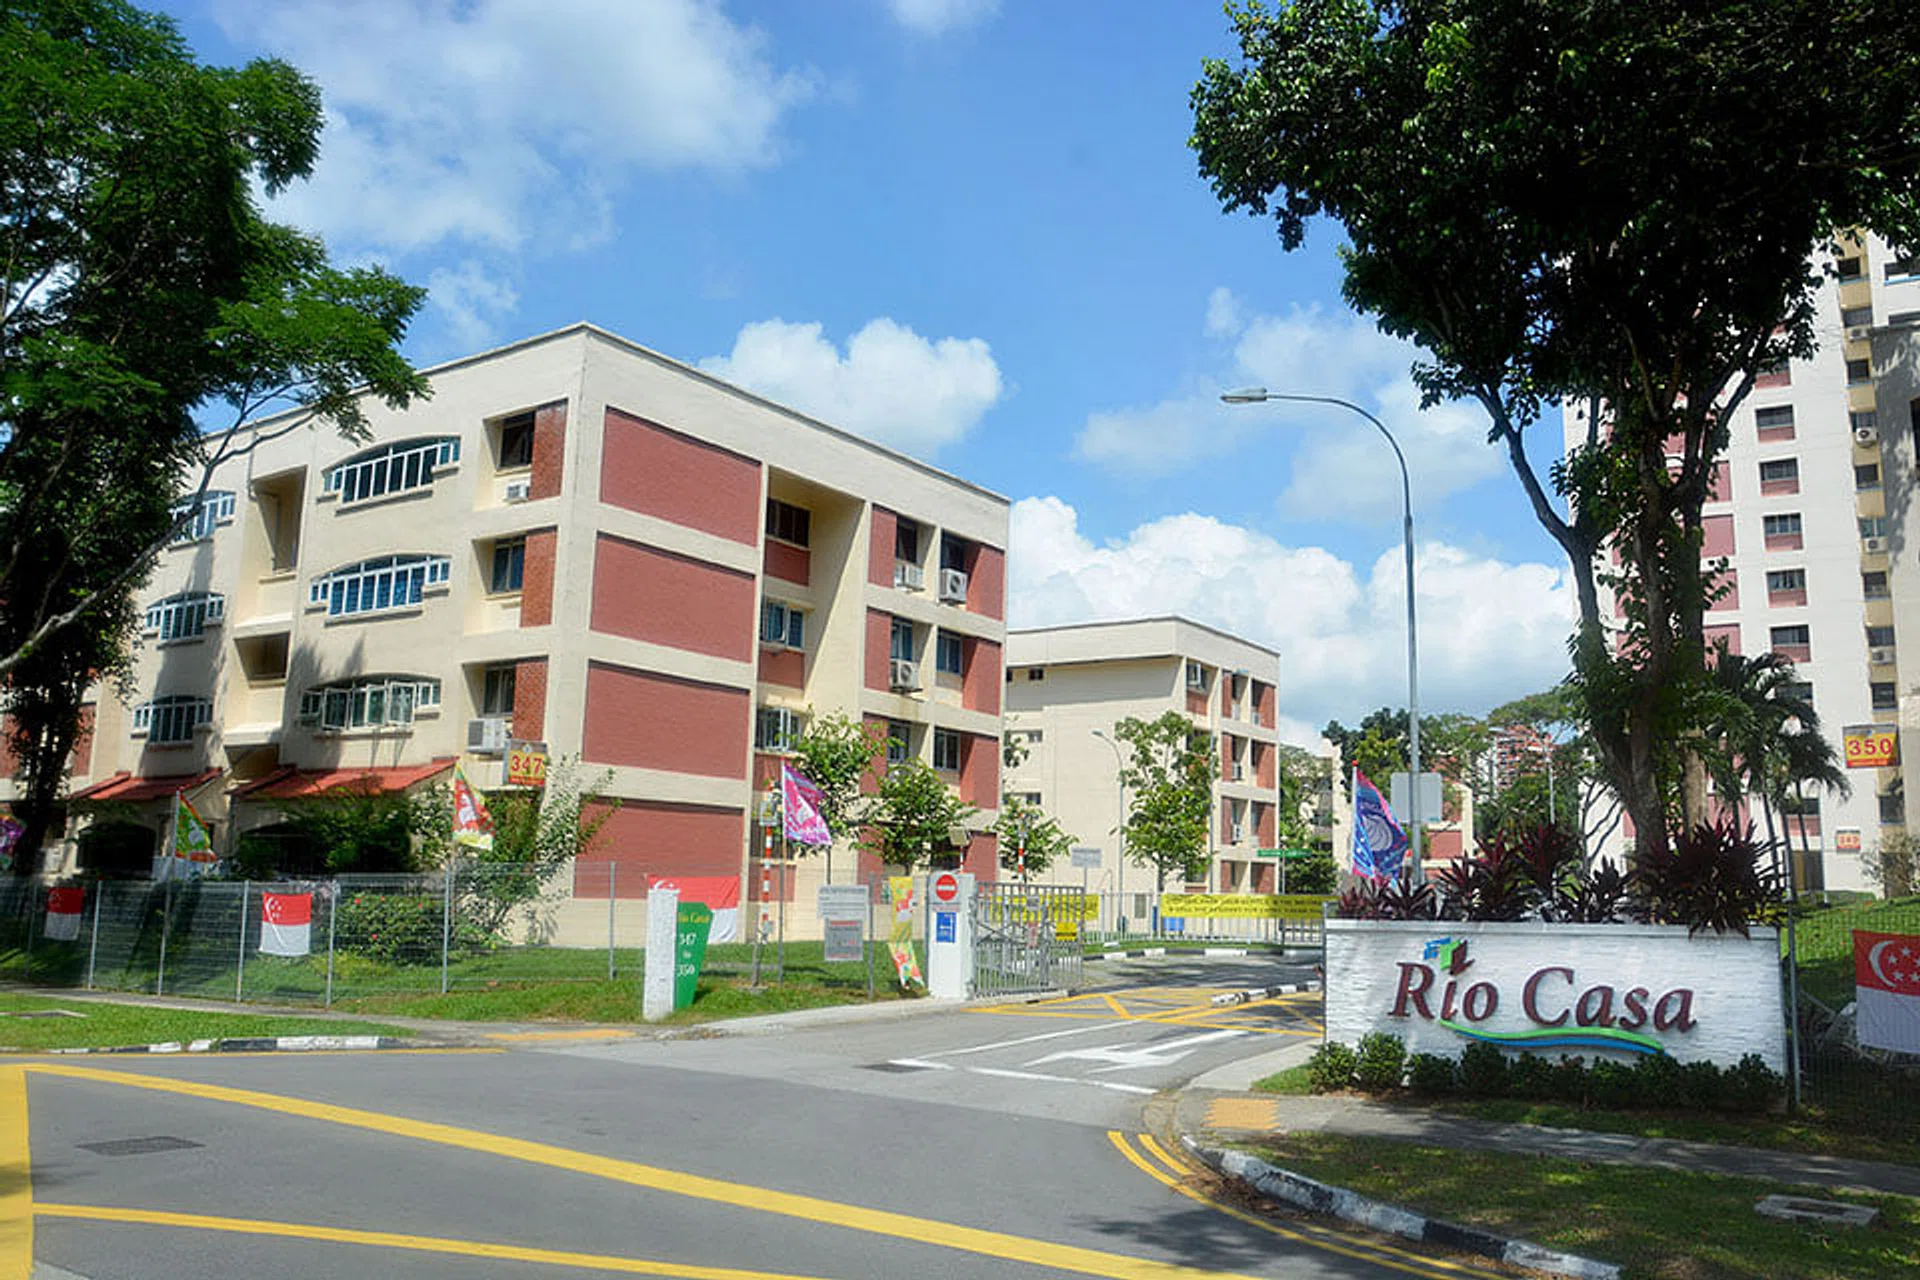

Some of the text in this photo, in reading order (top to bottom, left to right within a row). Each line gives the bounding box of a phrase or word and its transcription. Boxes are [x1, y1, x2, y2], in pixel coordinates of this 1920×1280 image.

[1848, 738, 1893, 756] 350
[511, 755, 543, 774] 347
[679, 932, 698, 946] 347
[676, 963, 696, 977] 350
[1387, 938, 1697, 1033] Rio Casa
